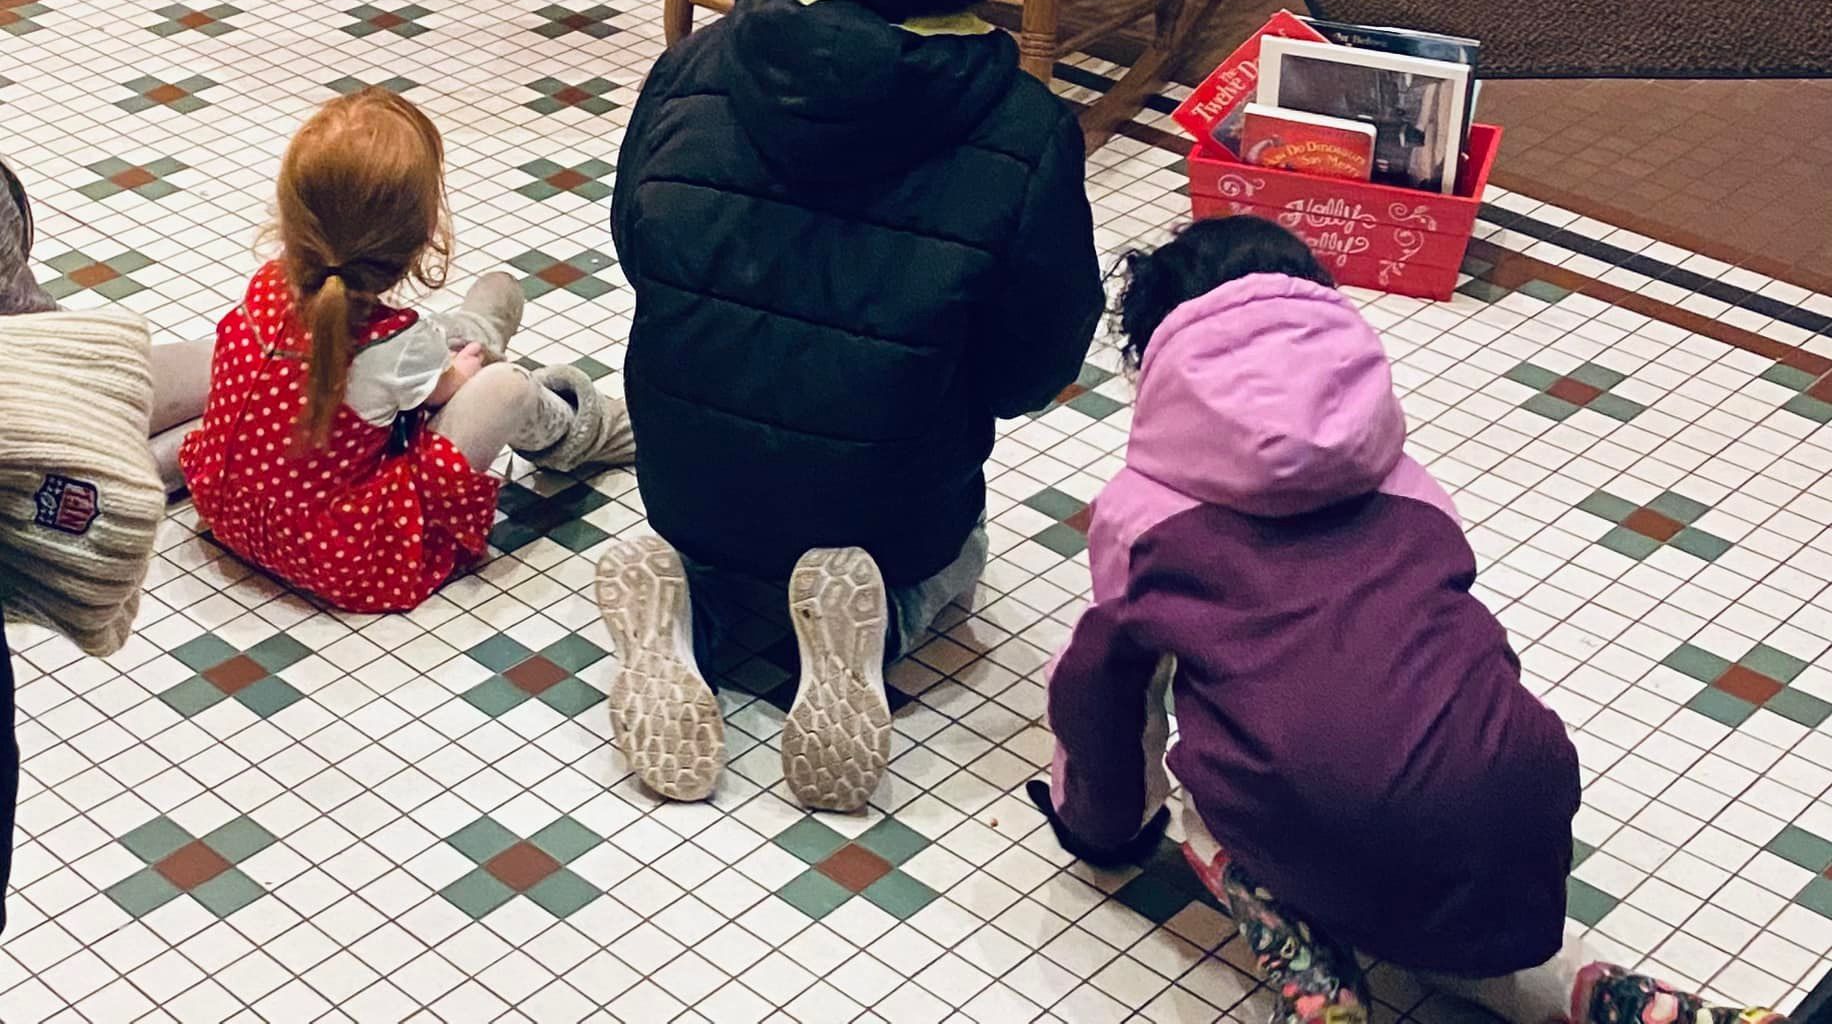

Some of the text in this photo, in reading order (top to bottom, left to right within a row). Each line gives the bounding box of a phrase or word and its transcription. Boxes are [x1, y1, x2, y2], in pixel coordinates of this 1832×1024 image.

[1191, 77, 1247, 123] Twelve
[1286, 143, 1306, 157] Do
[1305, 140, 1366, 166] Dinosaurs
[1278, 197, 1377, 234] Holly
[1294, 230, 1370, 267] olly
